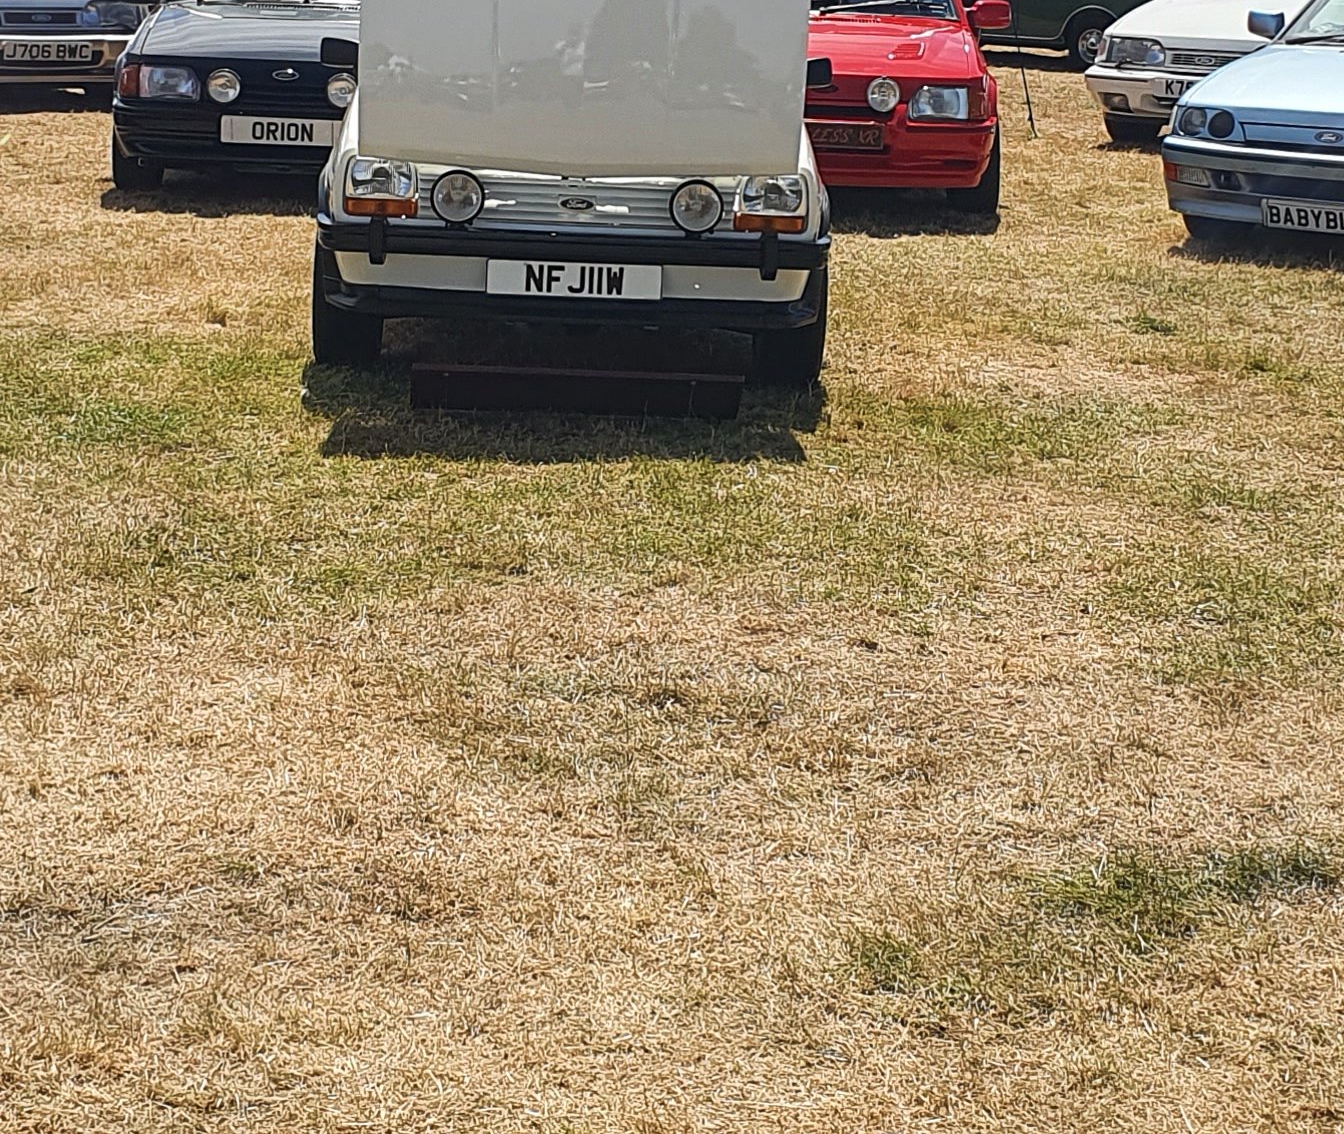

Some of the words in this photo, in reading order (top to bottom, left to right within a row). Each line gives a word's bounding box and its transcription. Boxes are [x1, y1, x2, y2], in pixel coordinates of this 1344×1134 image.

[6, 44, 51, 59] J706
[56, 44, 90, 59] BWC
[252, 121, 313, 142] ORION
